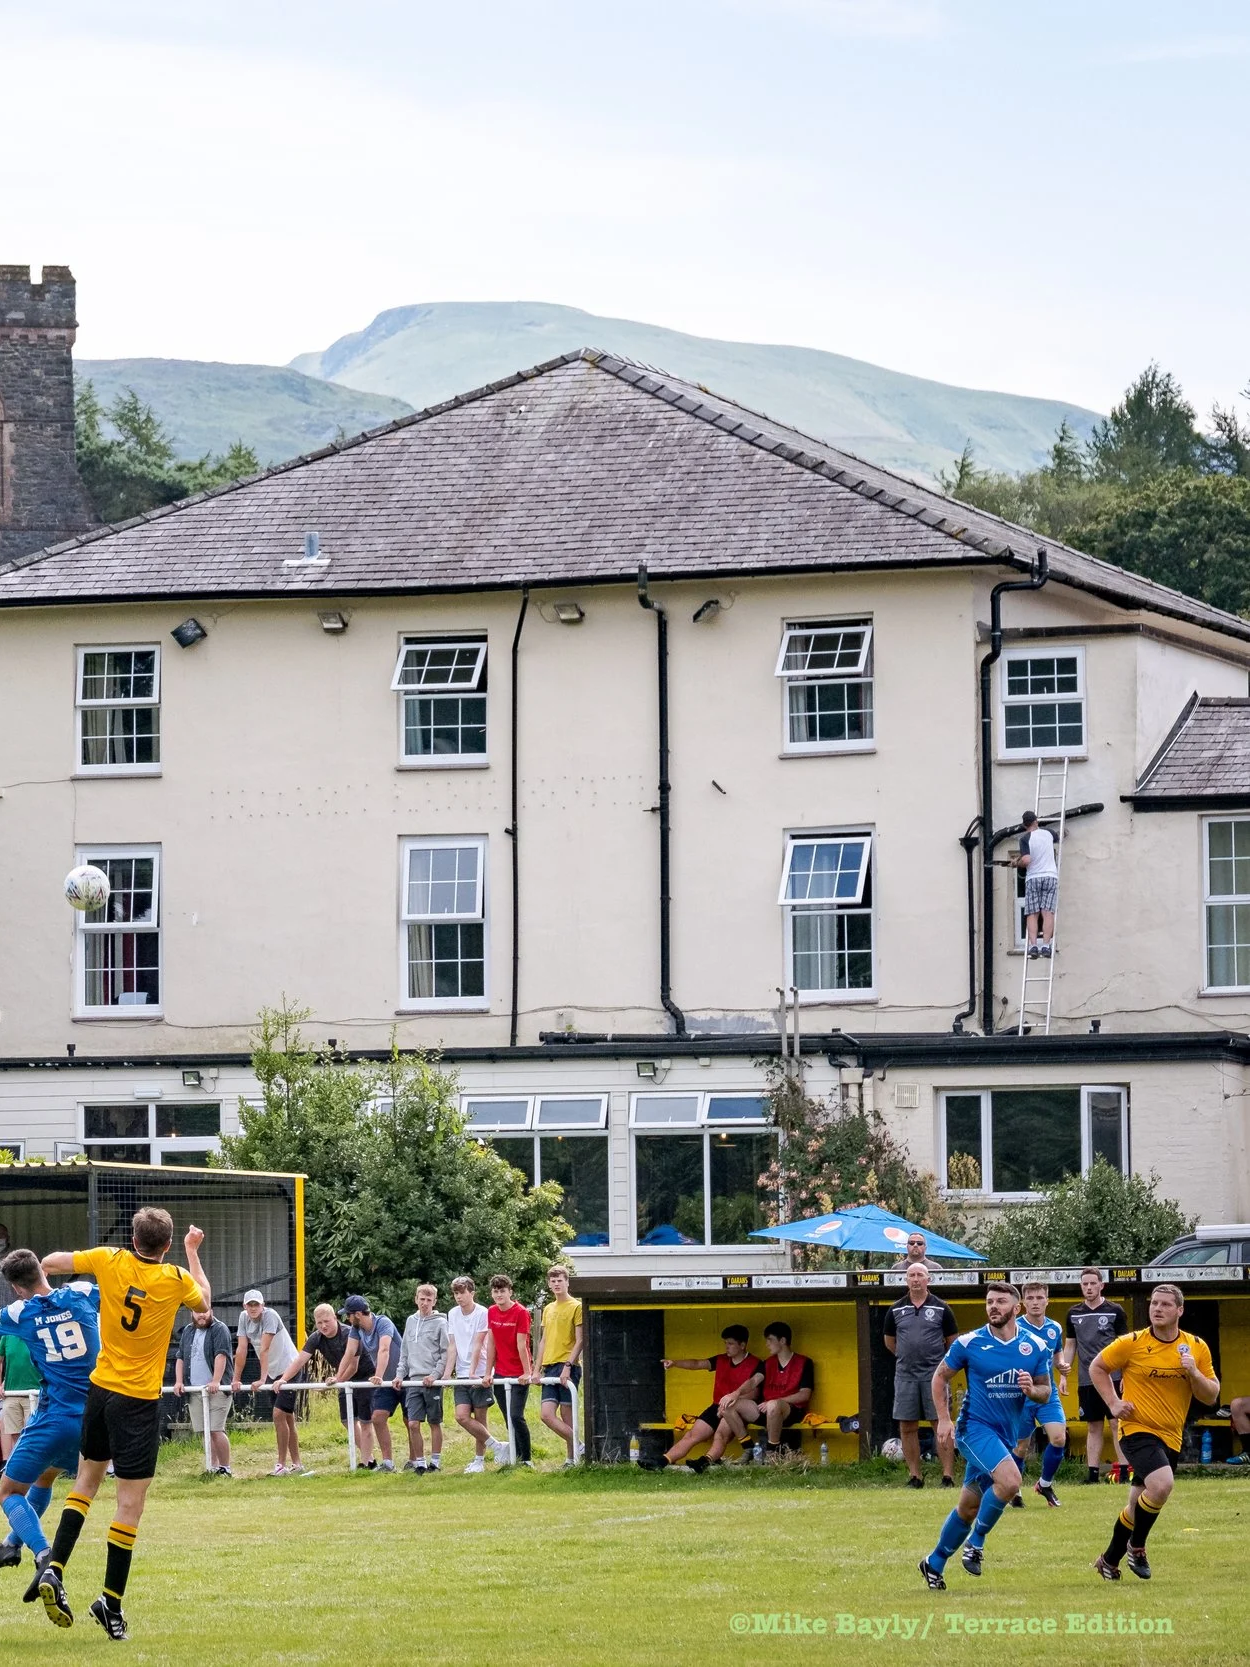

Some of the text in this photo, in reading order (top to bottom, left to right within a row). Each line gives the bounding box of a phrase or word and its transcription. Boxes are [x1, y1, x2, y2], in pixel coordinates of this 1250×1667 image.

[34, 1310, 73, 1326] M JONES
[121, 1285, 147, 1332] 5
[36, 1320, 88, 1363] 19
